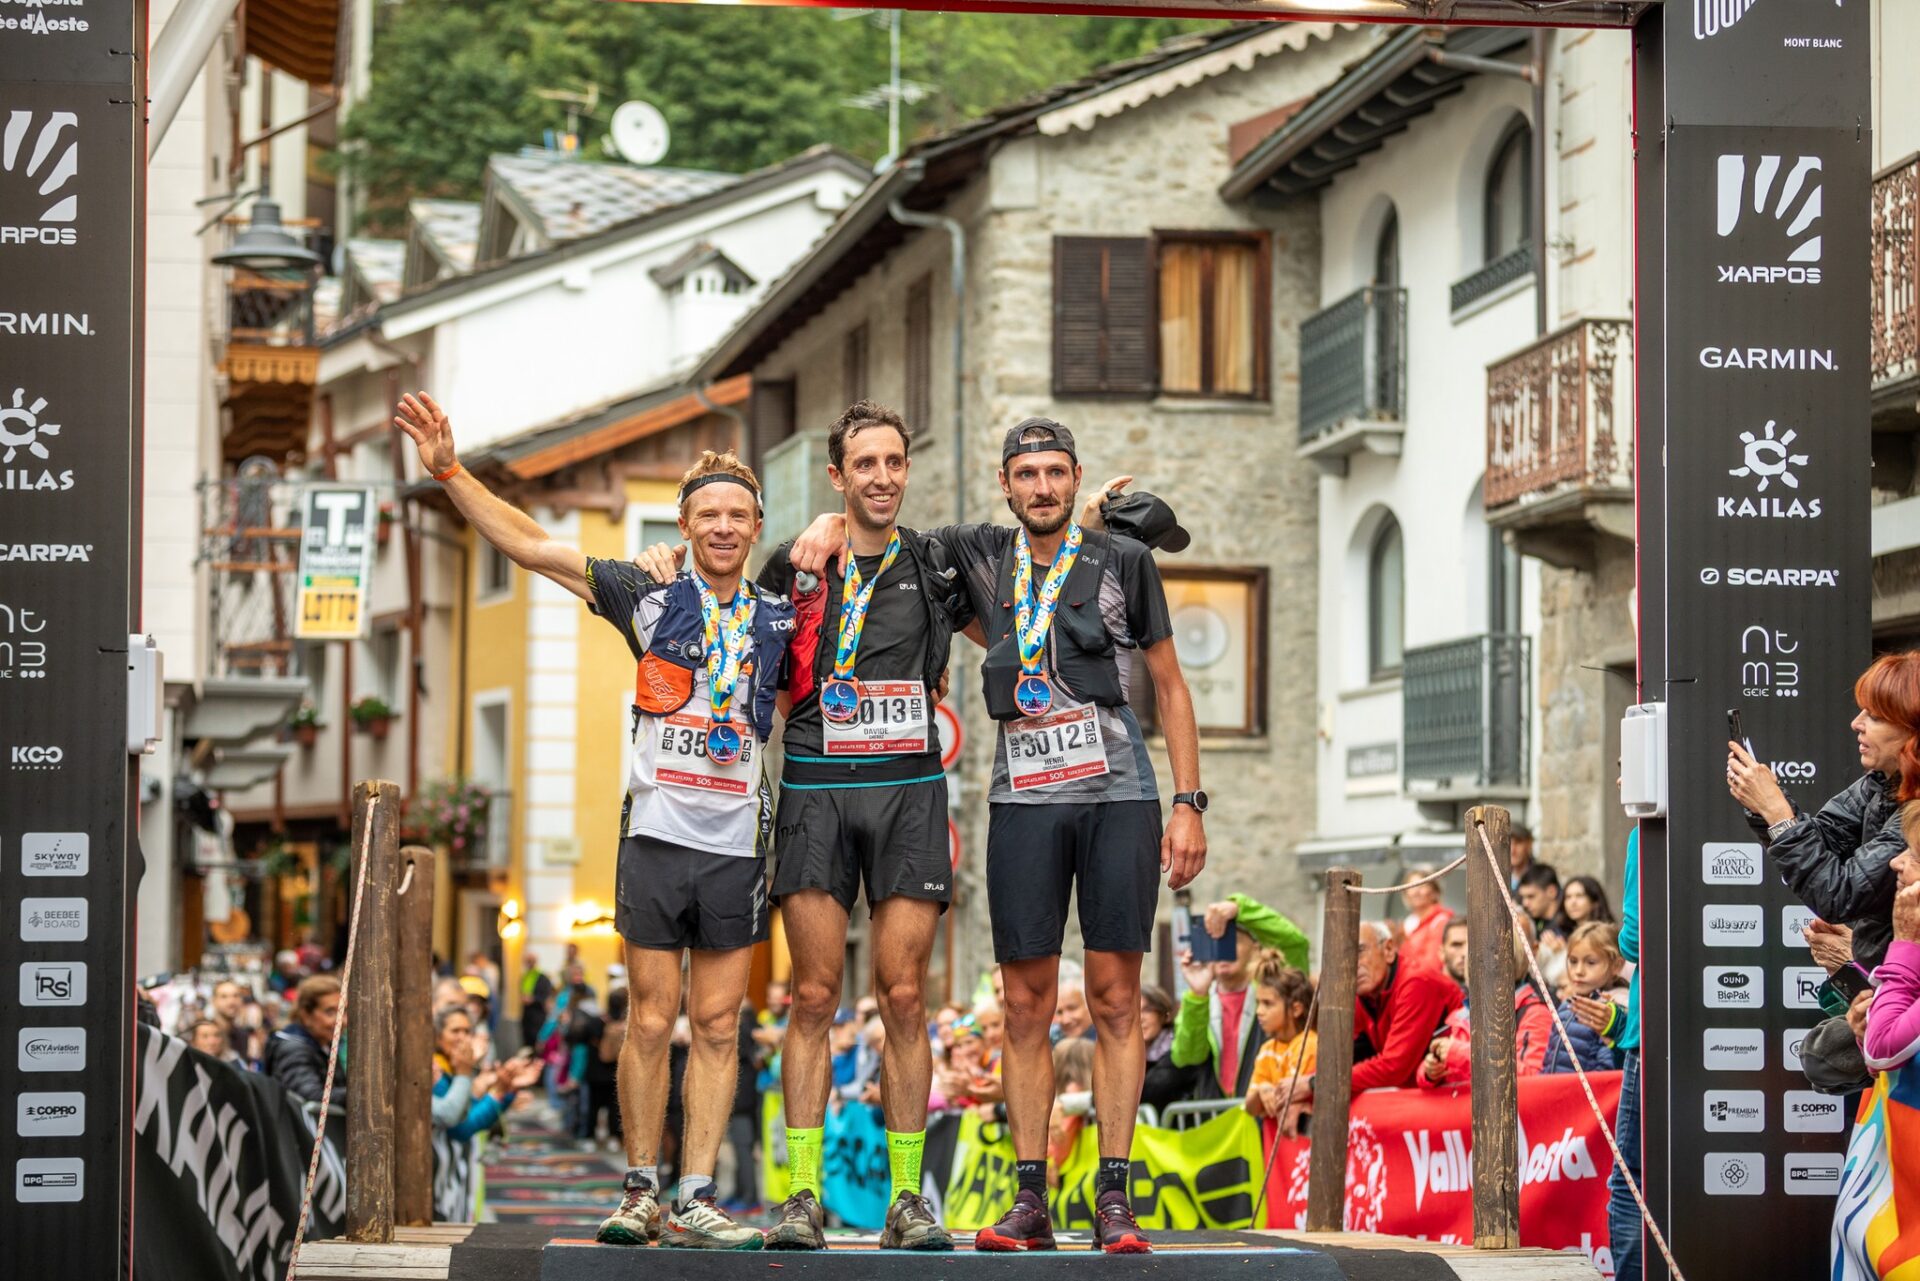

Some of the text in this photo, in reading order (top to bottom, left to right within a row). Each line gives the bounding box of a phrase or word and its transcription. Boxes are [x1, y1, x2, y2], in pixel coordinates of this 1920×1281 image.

[20, 9, 89, 34] d'Aoste
[1784, 38, 1843, 49] MONT BLANC
[1717, 265, 1822, 284] KARPOS
[1699, 347, 1832, 371] GARMIN
[1717, 496, 1822, 519] KAILAS
[1727, 567, 1837, 587] SCARPA
[863, 728, 890, 736] DAVIDE
[1021, 724, 1083, 758] 3012
[869, 742, 885, 750] SOS
[1043, 756, 1066, 766] HENRI
[1050, 771, 1066, 781] SOS
[695, 777, 712, 786] SOS
[1716, 858, 1748, 866] MONTE
[1711, 865, 1755, 876] BIANCO
[45, 911, 80, 919] BEEBEE
[44, 920, 80, 928] BOARD
[1723, 976, 1744, 984] DUNI
[37, 1106, 77, 1115] COPRO
[1801, 1104, 1837, 1113] COPRO
[1402, 1129, 1473, 1213] Vall
[1791, 1170, 1808, 1178] BPG
[24, 1177, 42, 1185] BPG
